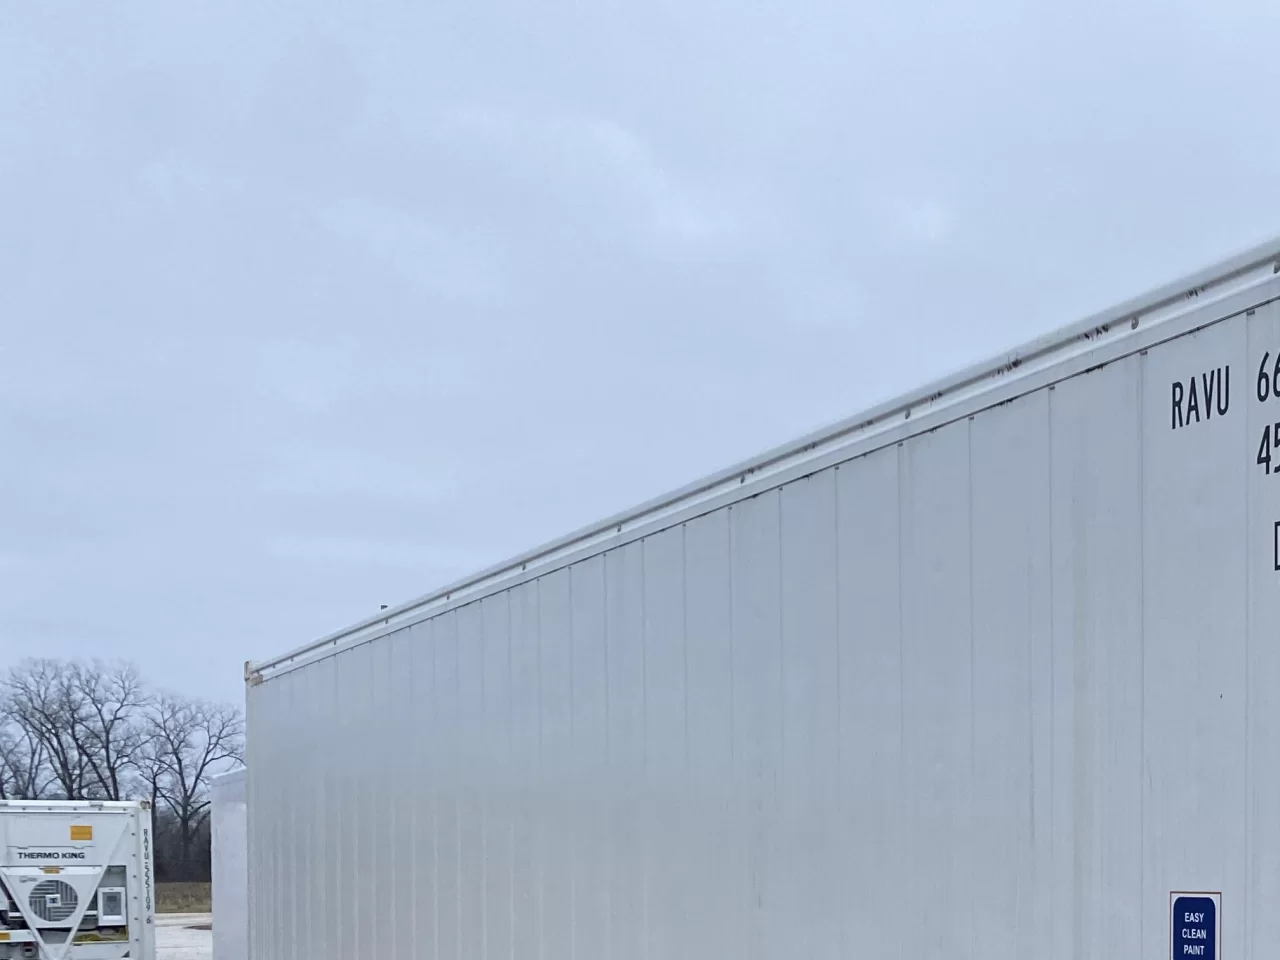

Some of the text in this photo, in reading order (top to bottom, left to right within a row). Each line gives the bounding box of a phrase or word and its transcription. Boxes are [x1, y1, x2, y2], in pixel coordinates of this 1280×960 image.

[1171, 365, 1230, 430] RAVU
[1184, 912, 1205, 923] EASY
[1181, 928, 1207, 939] CLEAN
[1183, 944, 1205, 956] PAINT
